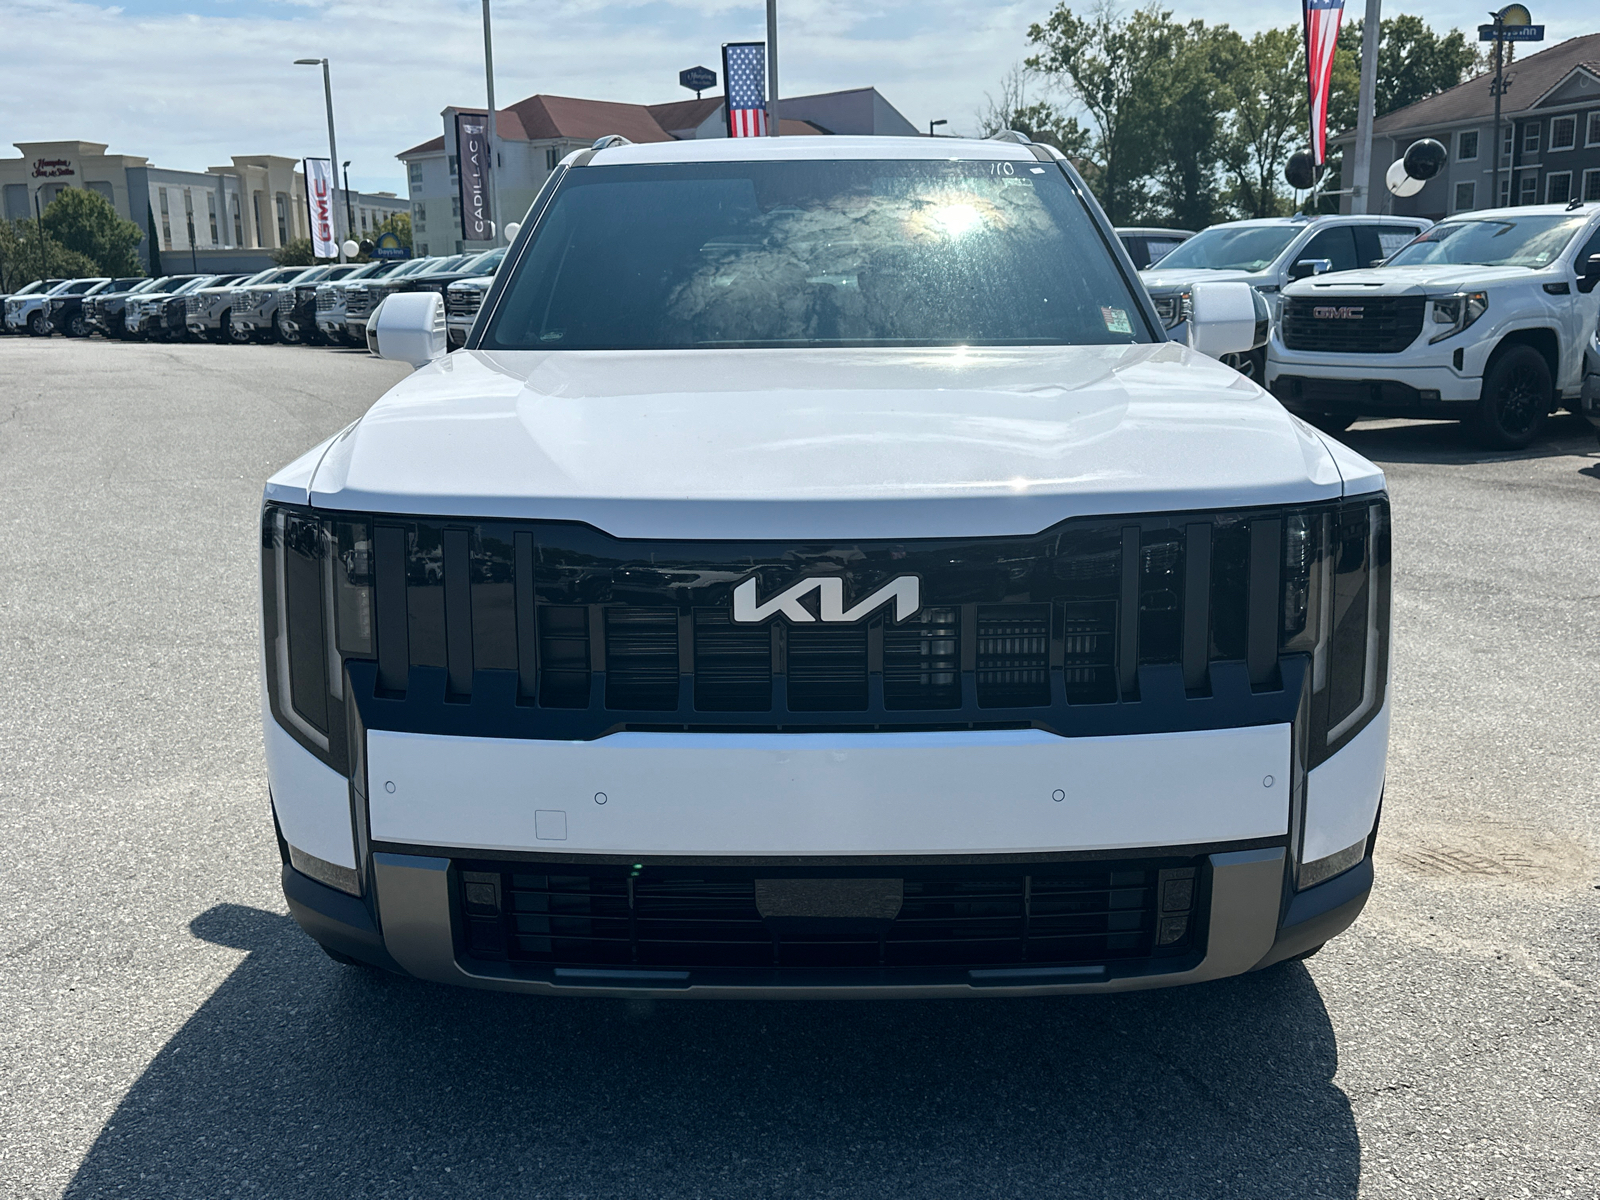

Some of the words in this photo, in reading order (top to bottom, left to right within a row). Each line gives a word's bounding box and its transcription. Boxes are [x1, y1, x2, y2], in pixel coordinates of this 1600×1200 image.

[33, 158, 71, 169] Hampton
[469, 140, 484, 233] CADILLAC
[313, 178, 332, 242] GMC
[1313, 306, 1365, 319] GMC
[733, 575, 920, 622] KIA
